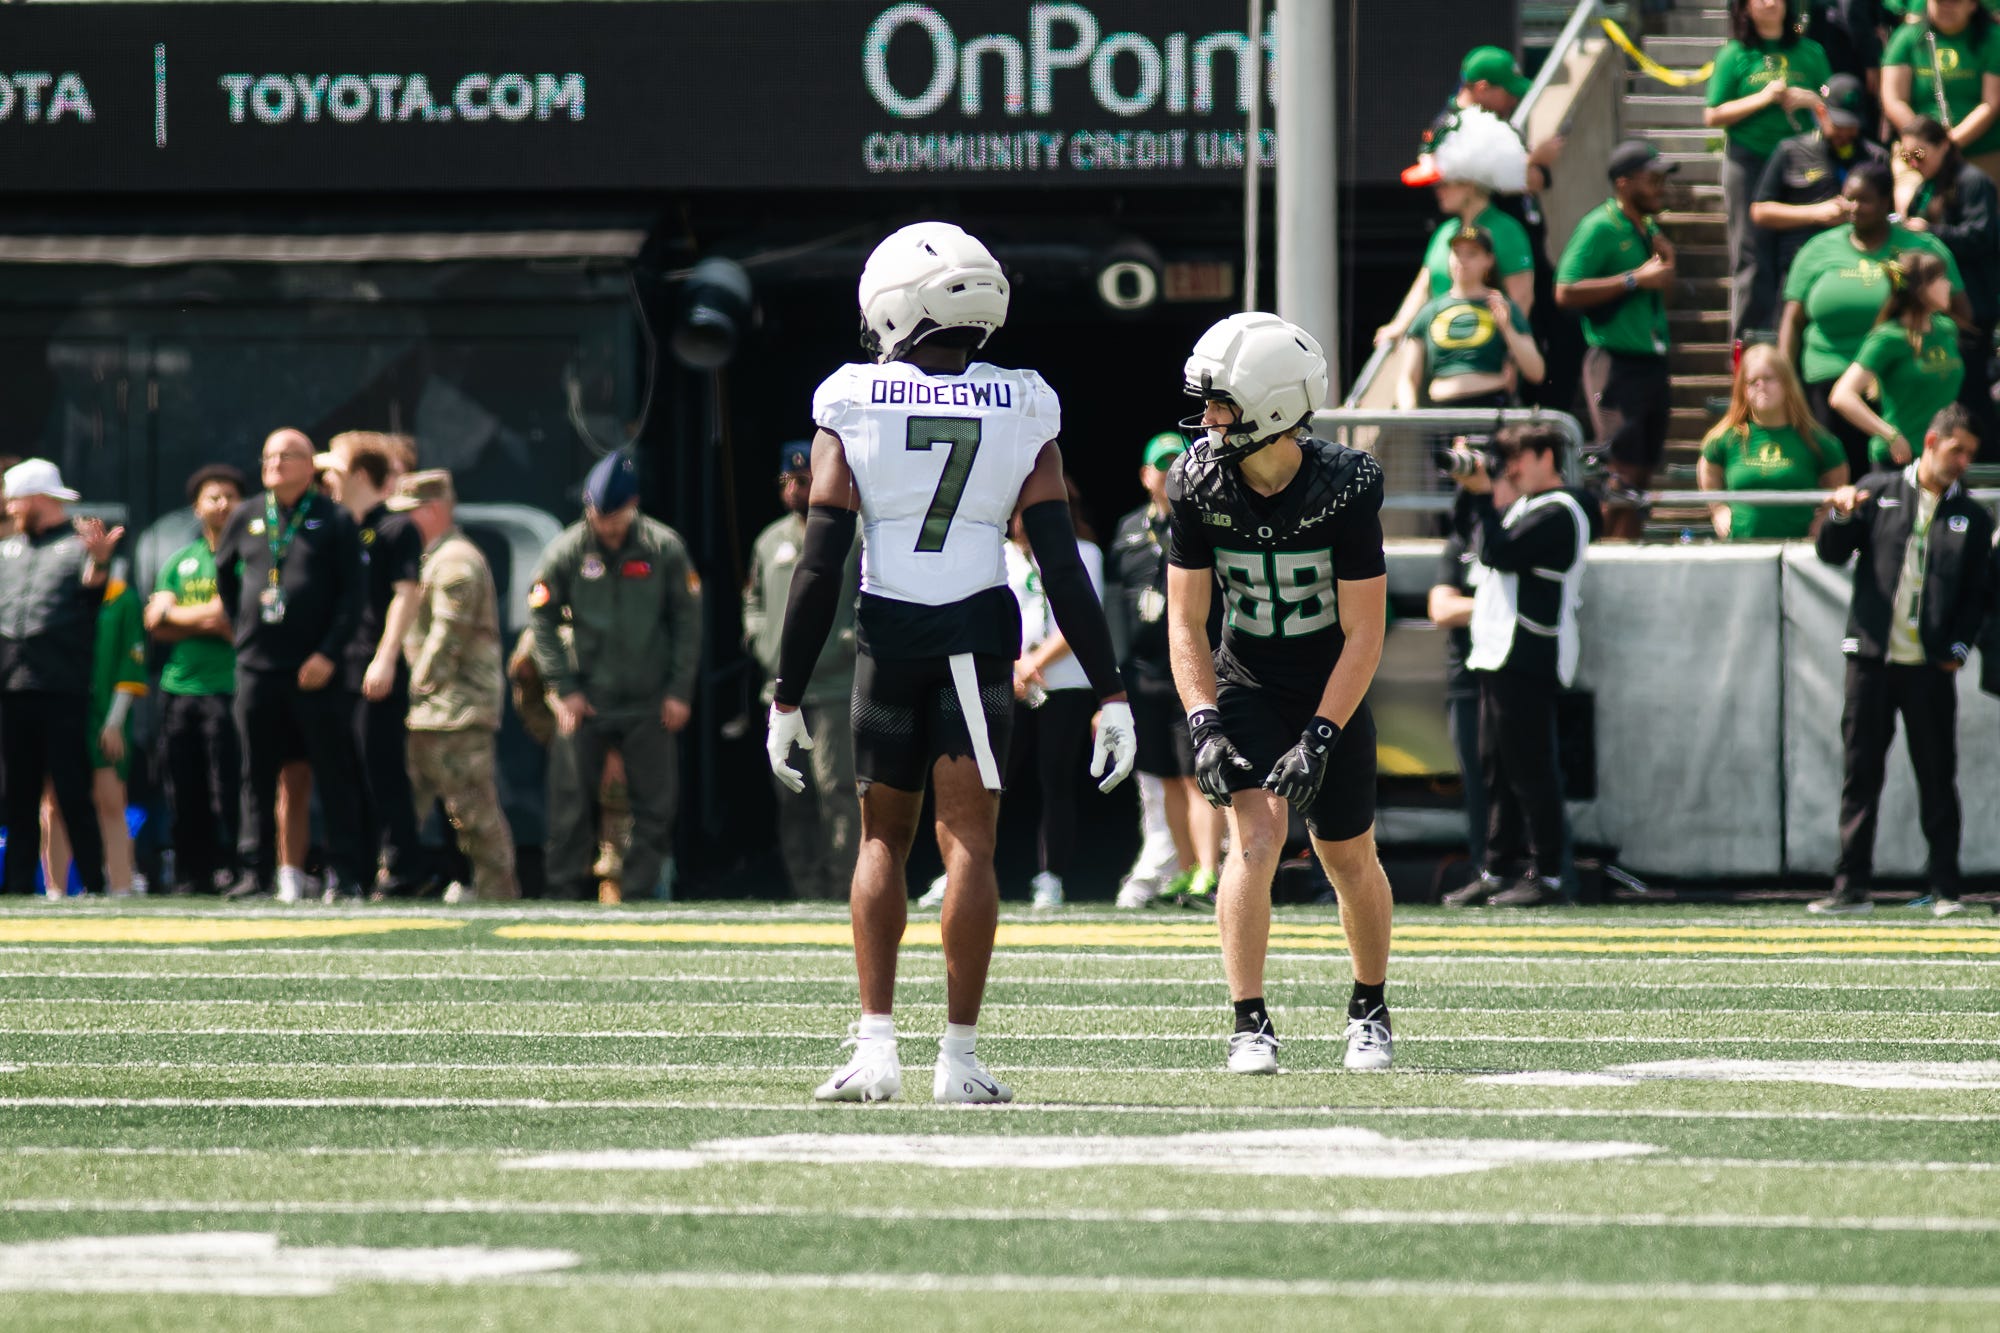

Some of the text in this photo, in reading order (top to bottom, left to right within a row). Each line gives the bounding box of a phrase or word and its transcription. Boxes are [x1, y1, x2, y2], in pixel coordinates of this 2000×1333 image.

[218, 73, 587, 123] TOYOTA.COM
[862, 129, 1278, 173] COMMUNITY CREDIT UNO
[1098, 262, 1156, 309] O
[1430, 304, 1495, 349] O
[871, 379, 1012, 409] OBIDEGWU
[905, 415, 983, 552] 7
[1257, 526, 1273, 538] O
[1213, 546, 1338, 639] 89
